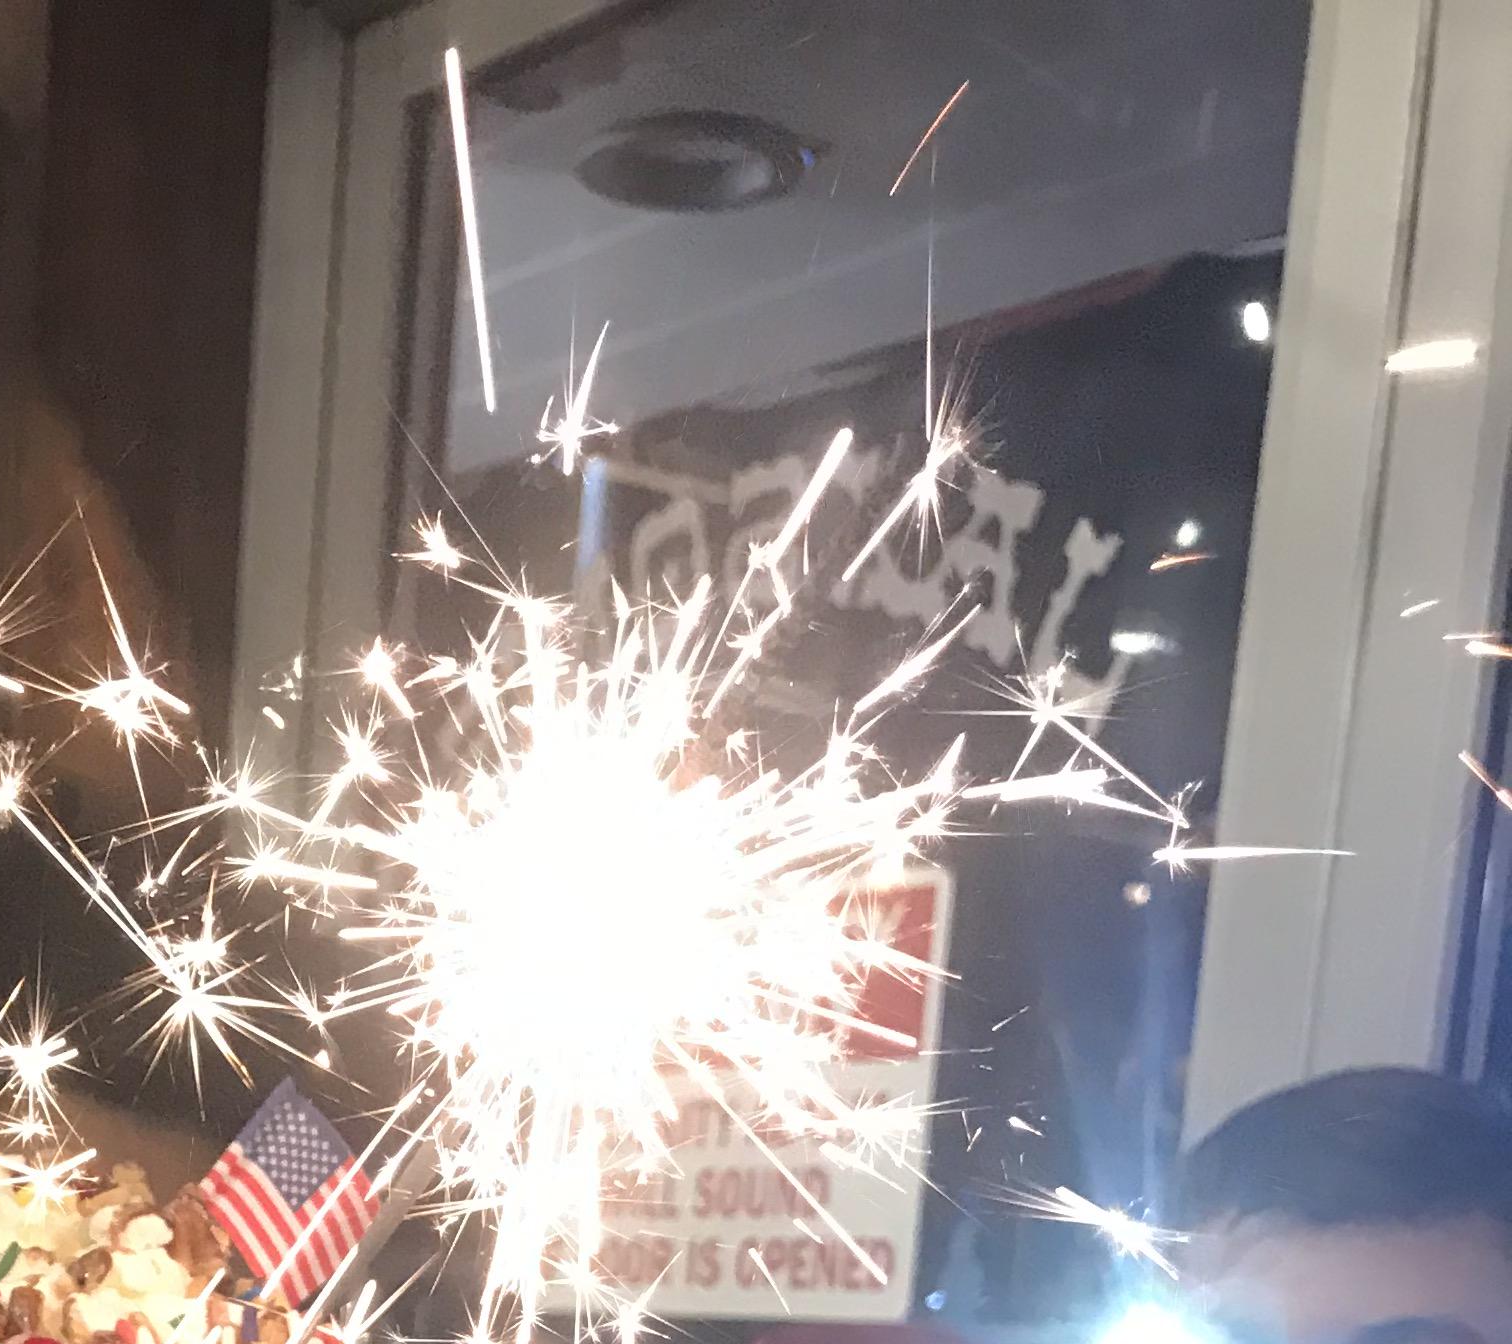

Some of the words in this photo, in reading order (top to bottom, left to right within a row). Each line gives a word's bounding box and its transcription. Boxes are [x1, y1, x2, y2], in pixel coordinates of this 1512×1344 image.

[695, 1166, 832, 1220] SOUND
[686, 1237, 721, 1289] IS
[736, 1236, 897, 1292] OPENED
